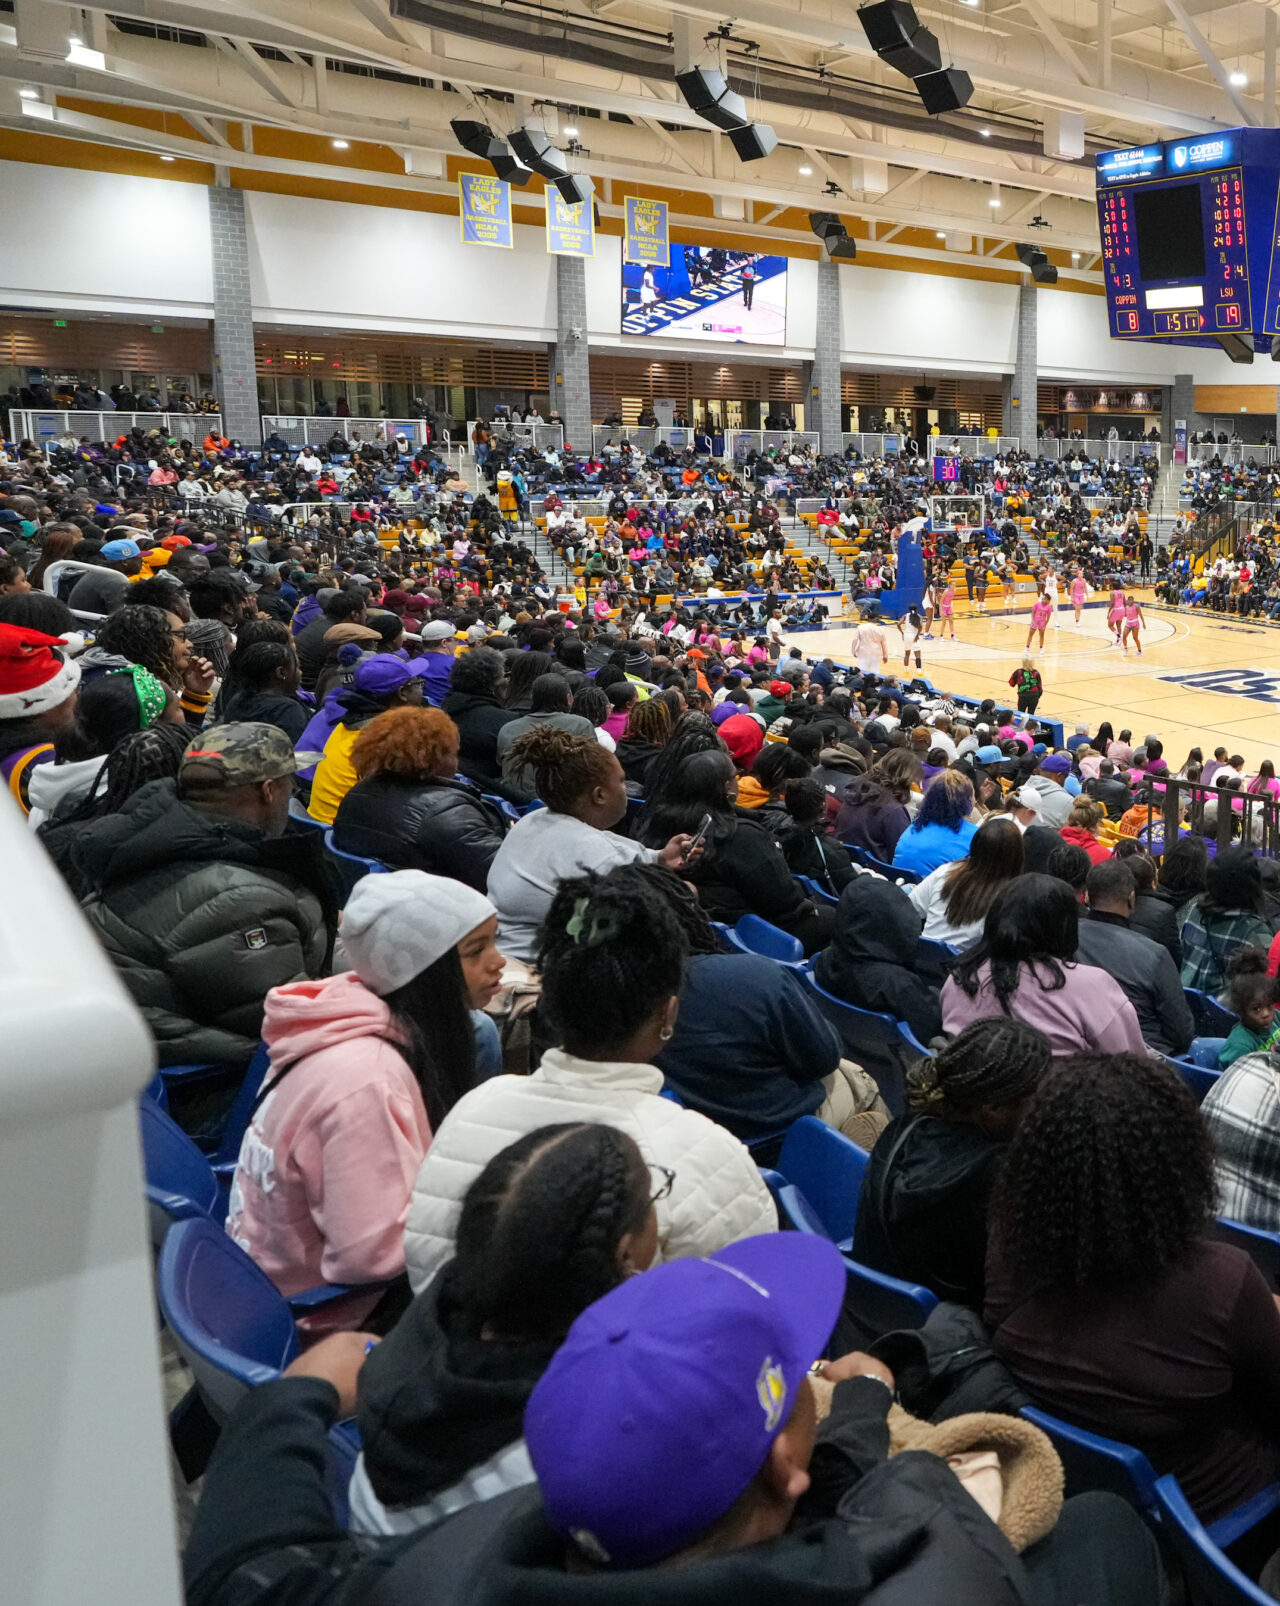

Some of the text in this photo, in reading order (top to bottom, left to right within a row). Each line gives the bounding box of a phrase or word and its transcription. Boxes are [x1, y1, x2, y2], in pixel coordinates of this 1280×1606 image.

[1190, 141, 1224, 155] COPPIN
[1114, 151, 1128, 162] TEXT
[473, 178, 498, 186] LADY
[1222, 182, 1228, 193] 0
[1234, 180, 1240, 192] 0
[470, 184, 502, 194] EAGLES
[636, 200, 656, 208] LADY
[1110, 199, 1115, 209] 0
[1120, 198, 1126, 208] 0
[1224, 196, 1228, 206] 2
[1235, 194, 1240, 205] 6
[634, 206, 660, 217] EAGLES
[1104, 212, 1110, 222] 5
[1214, 208, 1241, 220] 10 0 10
[466, 214, 507, 226] BASKETBALL
[475, 223, 499, 232] NCAA
[551, 226, 590, 235] BASKETBALL
[1112, 224, 1118, 234] 0
[1215, 220, 1242, 234] 12 0 0
[560, 234, 582, 242] NCAA
[630, 234, 665, 245] BASKETBALL
[1214, 234, 1244, 247] 24 0 3
[638, 243, 658, 251] NCAA
[1224, 265, 1244, 280] 2 4
[1114, 274, 1130, 288] 4 3
[1220, 288, 1234, 298] LSU
[1116, 294, 1136, 304] COPPIN
[1226, 306, 1238, 324] 19
[1128, 312, 1136, 330] 8
[942, 466, 956, 480] 30
